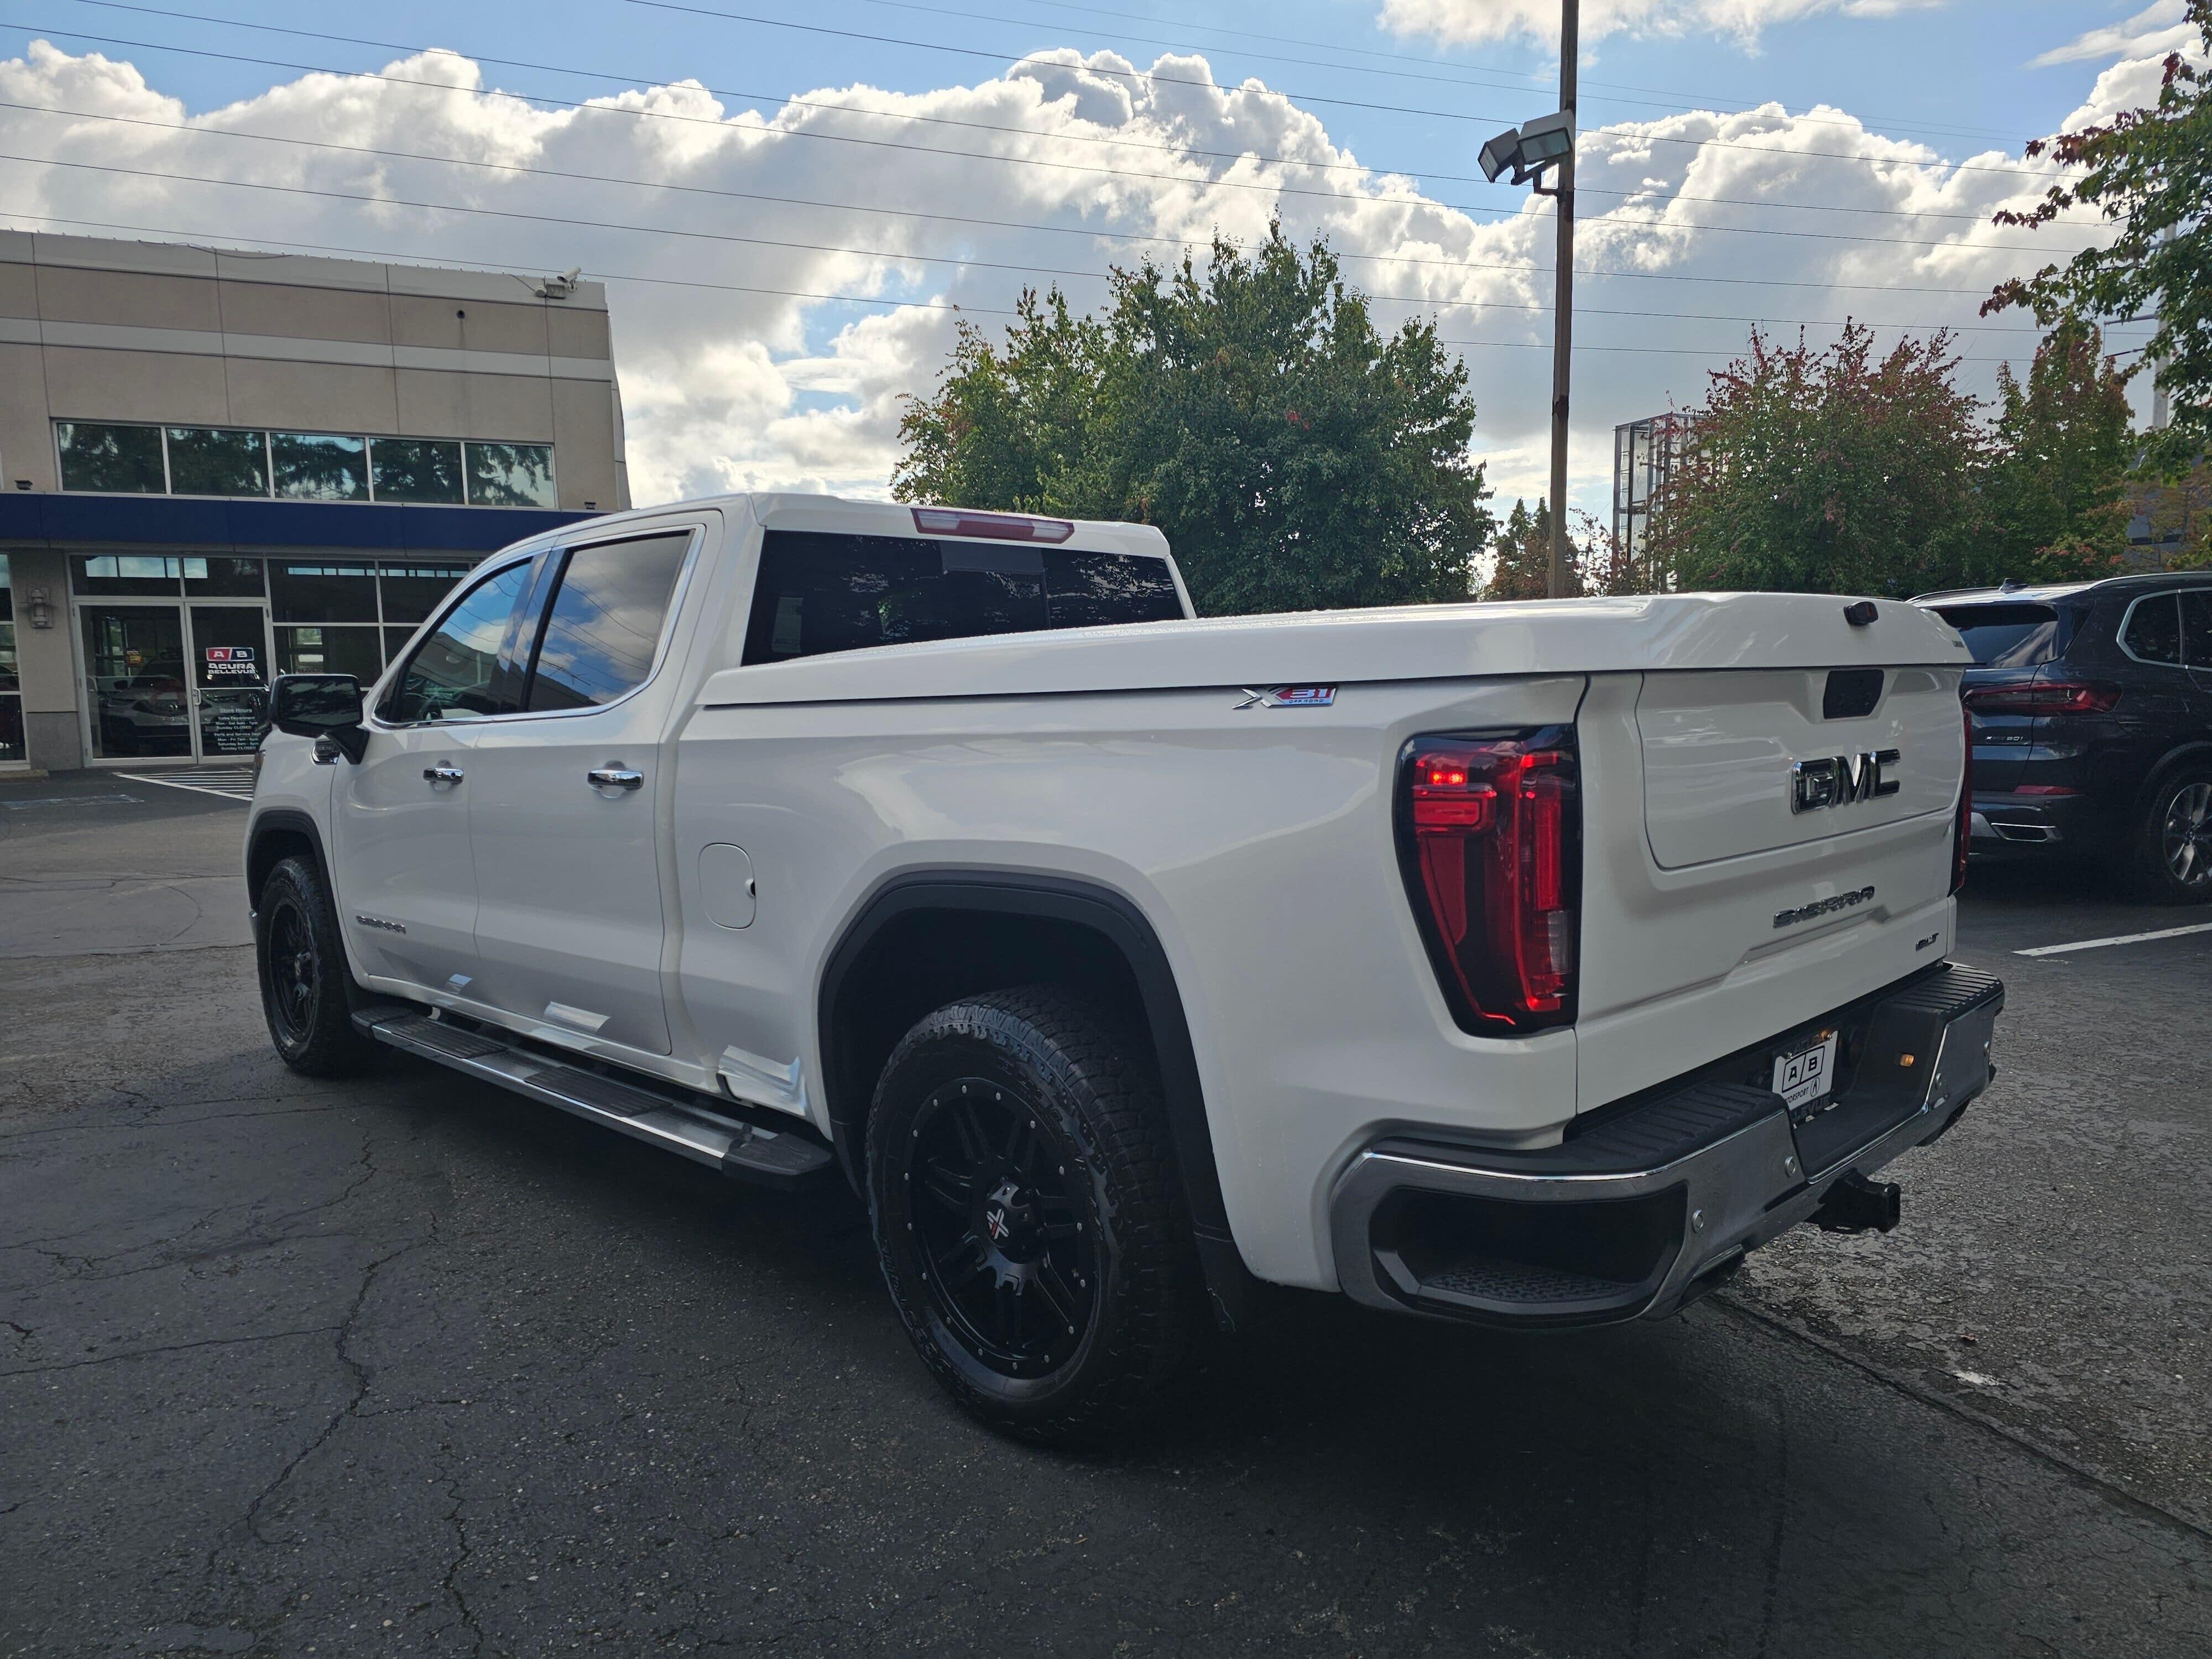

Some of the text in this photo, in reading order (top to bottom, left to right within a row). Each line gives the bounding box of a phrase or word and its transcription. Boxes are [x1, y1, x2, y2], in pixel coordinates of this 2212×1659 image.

[1791, 749, 1901, 815] GMC
[1773, 885, 1875, 928] SIERRA
[1788, 1056, 1817, 1081] A B
